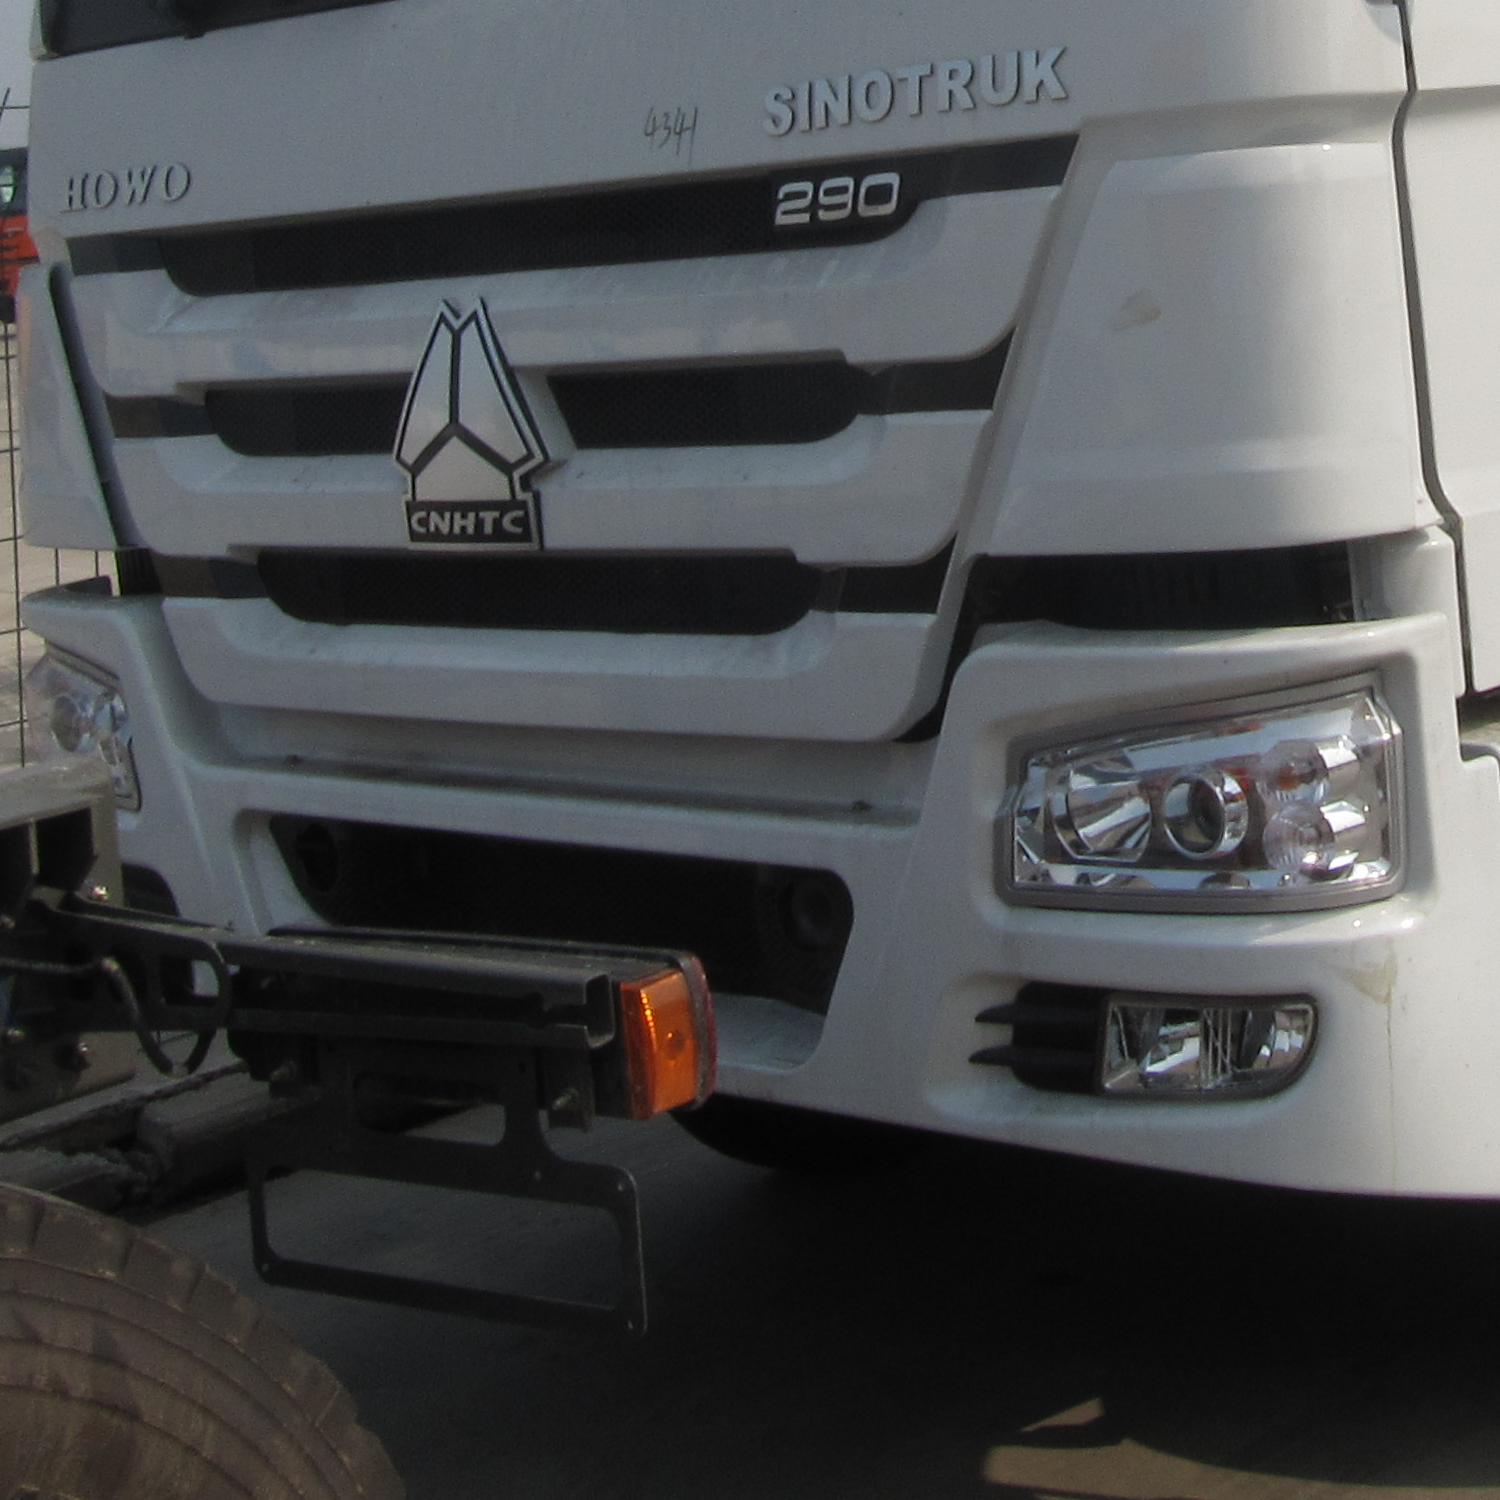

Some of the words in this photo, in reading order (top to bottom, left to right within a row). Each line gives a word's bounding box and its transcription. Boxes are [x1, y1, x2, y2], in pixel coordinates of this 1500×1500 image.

[763, 45, 1069, 138] SINOTRUK
[60, 161, 193, 214] HOWO
[773, 171, 901, 227] 290
[410, 509, 525, 537] CNHTC
